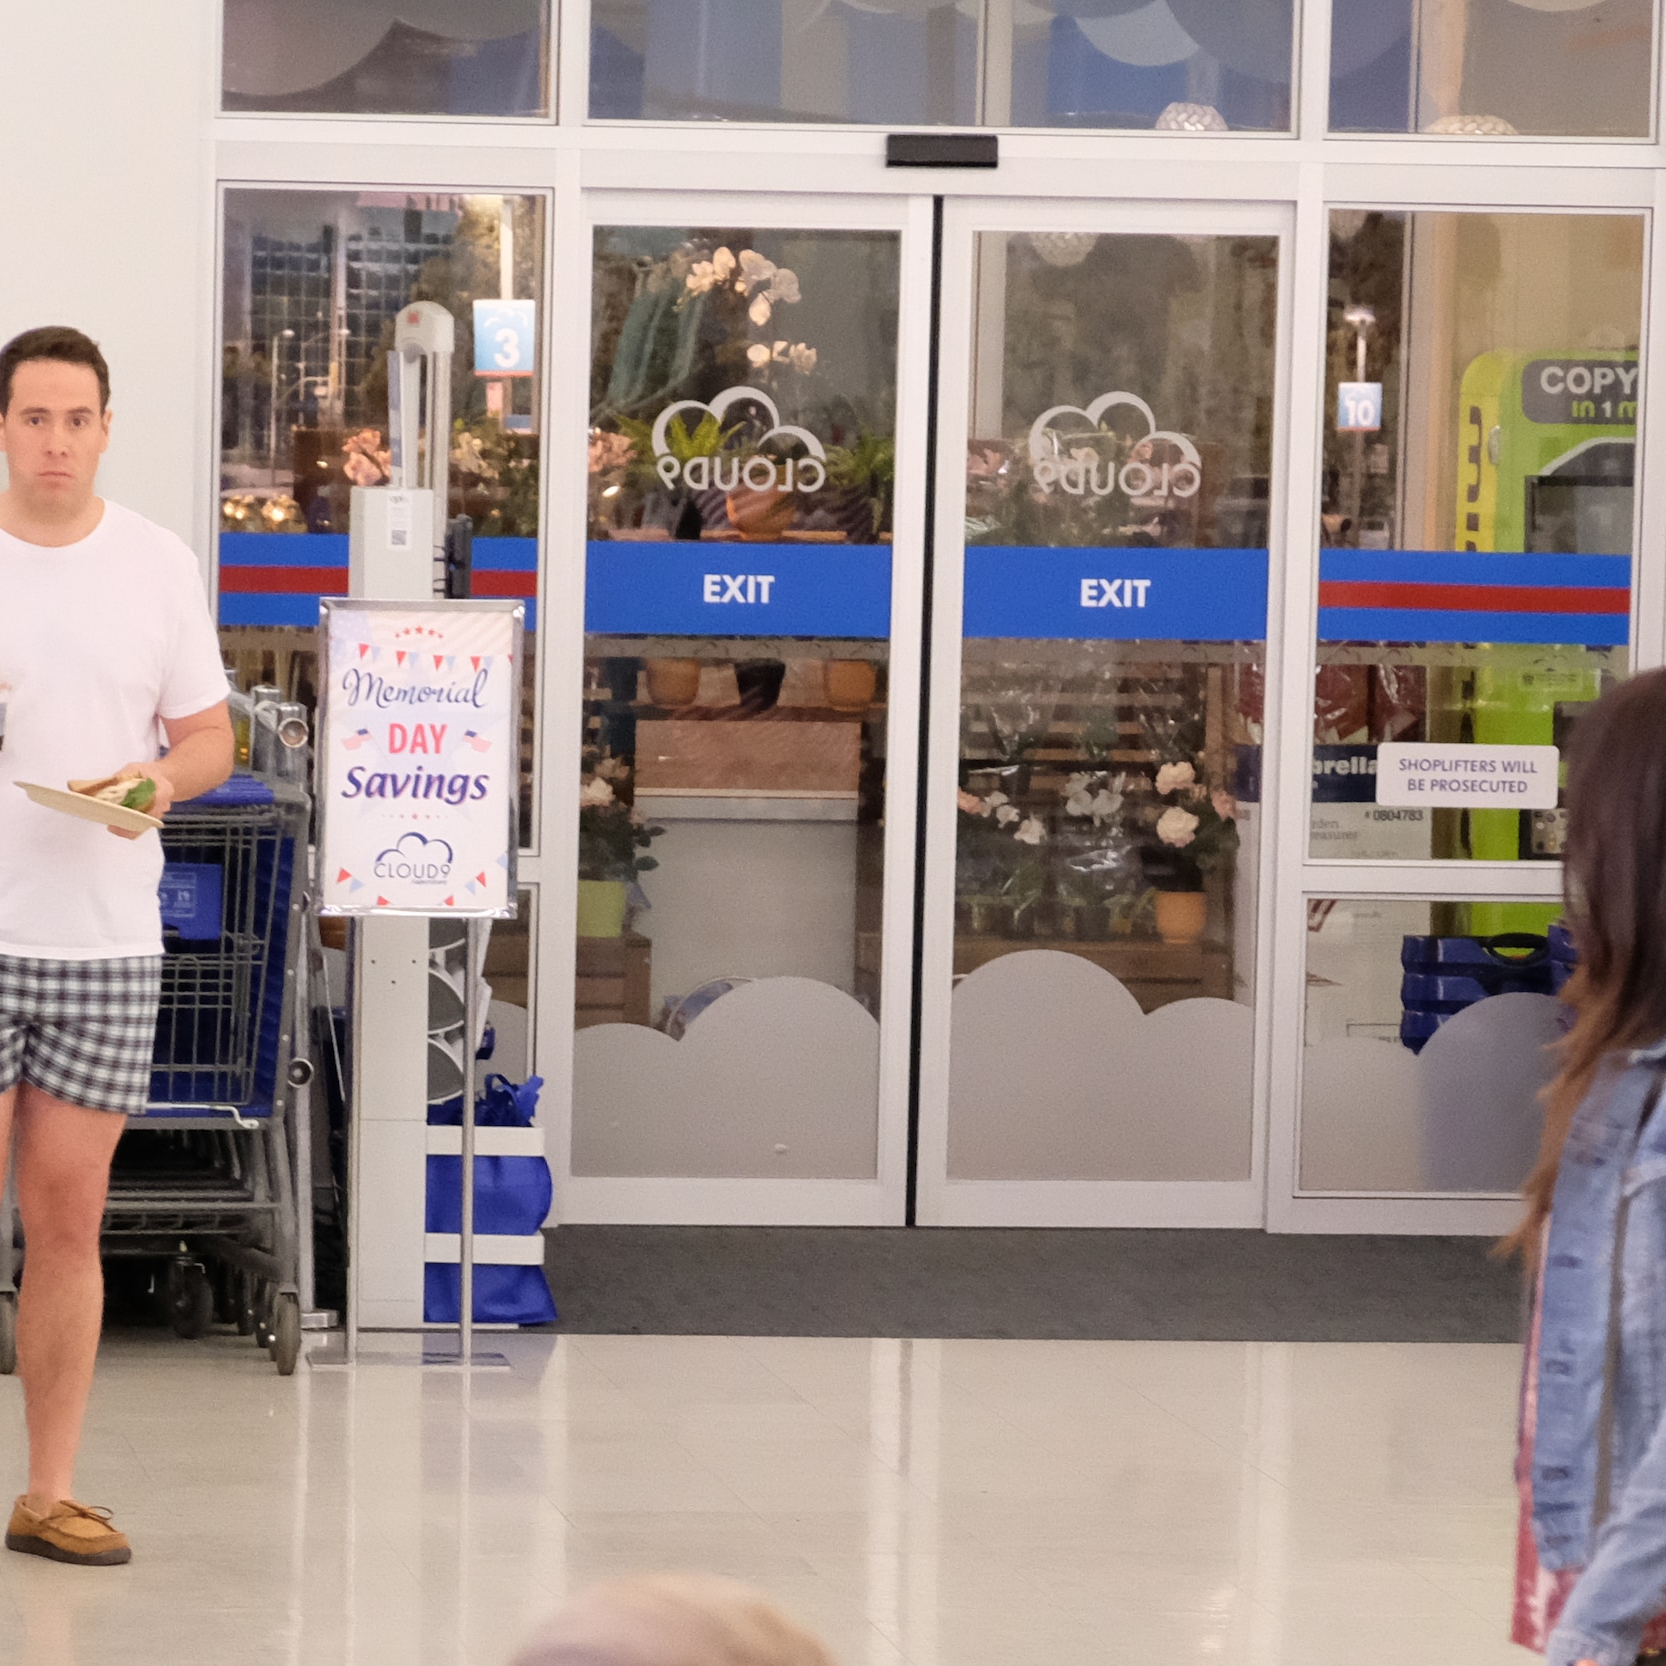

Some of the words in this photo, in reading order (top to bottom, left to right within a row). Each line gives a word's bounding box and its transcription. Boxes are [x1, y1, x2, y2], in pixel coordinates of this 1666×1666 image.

[494, 328, 521, 368] 3
[1540, 366, 1639, 394] COPY
[1344, 400, 1377, 427] 10
[702, 574, 776, 604] EXIT
[1079, 579, 1152, 608] EXIT
[342, 668, 490, 708] Memorial
[388, 722, 448, 755] DAY
[1398, 758, 1497, 773] SHOPLIFTERS
[1501, 760, 1539, 774] WILL
[341, 765, 490, 806] Savings
[1407, 778, 1425, 792] BE
[1430, 779, 1528, 793] PROSECUTED
[373, 862, 452, 879] CLOUD9
